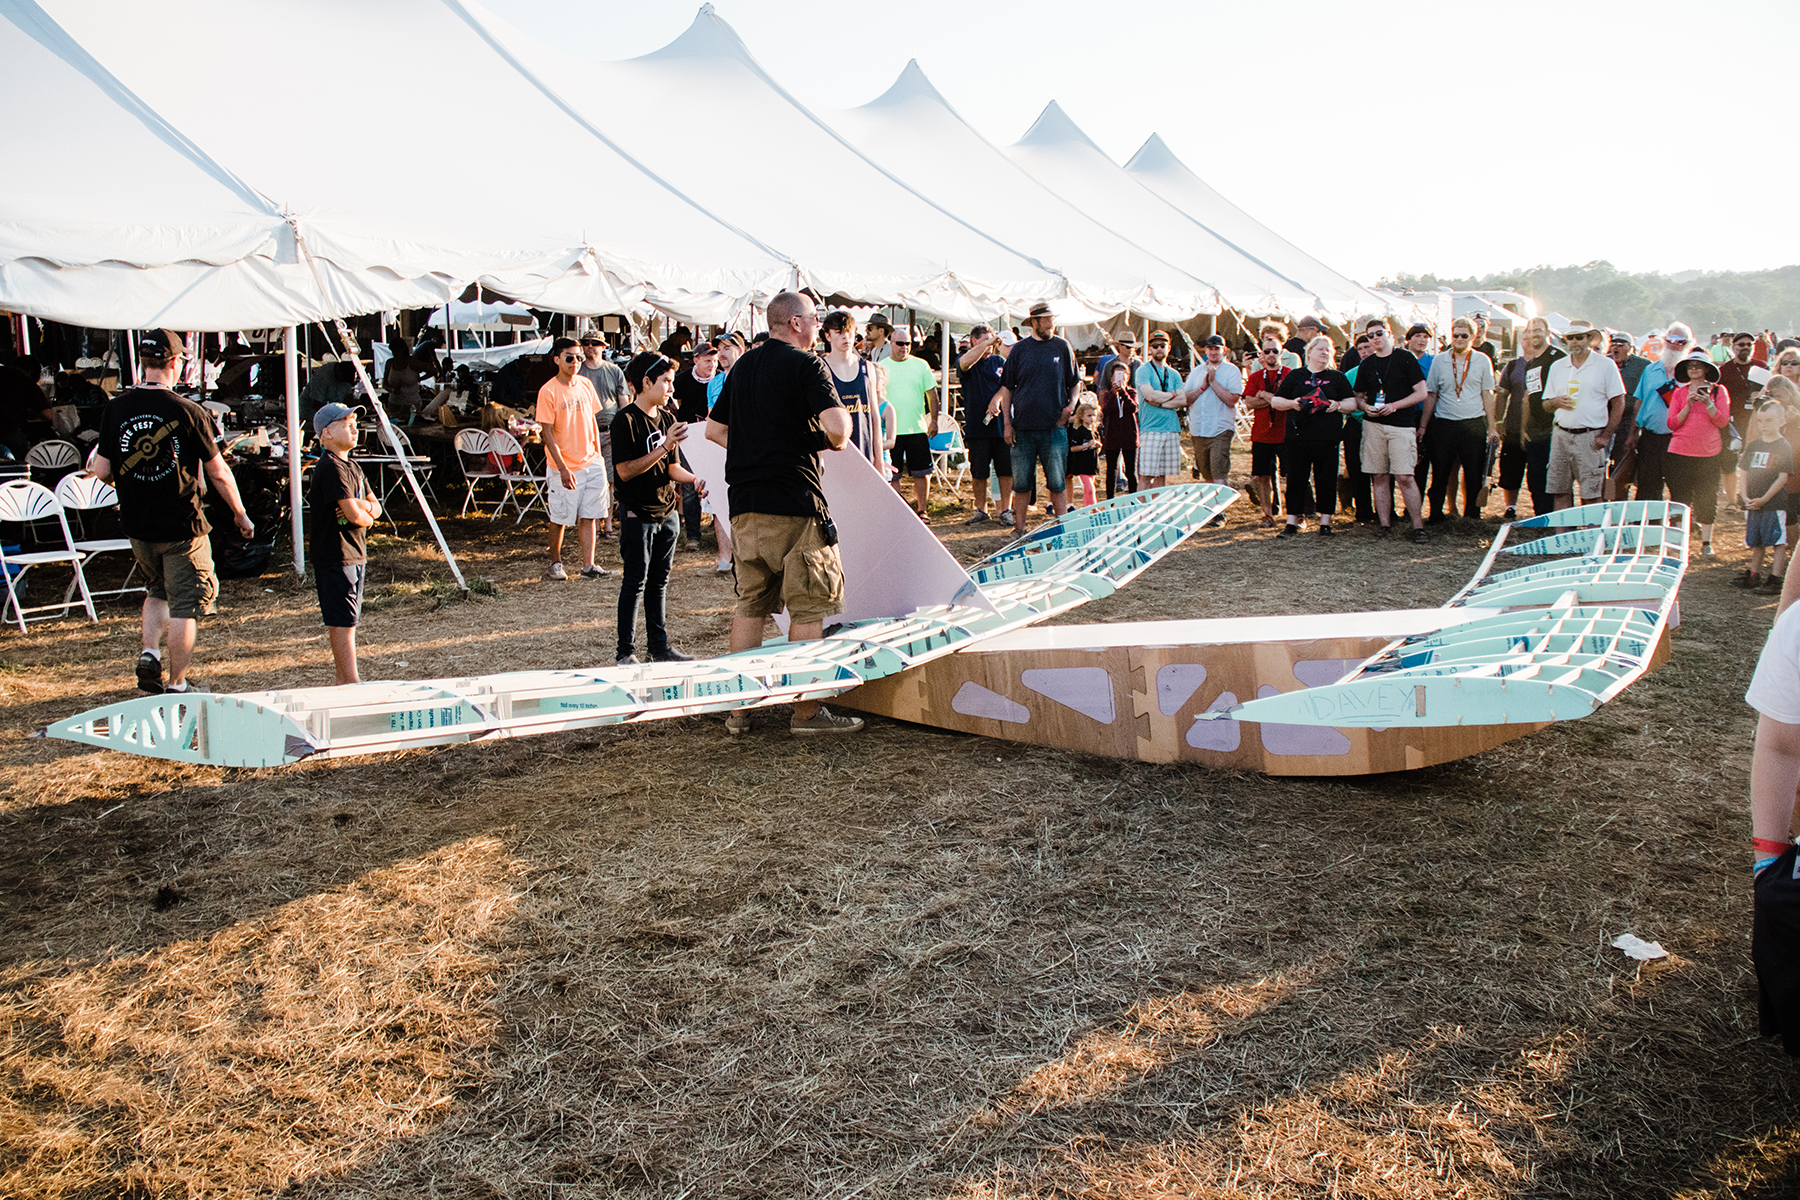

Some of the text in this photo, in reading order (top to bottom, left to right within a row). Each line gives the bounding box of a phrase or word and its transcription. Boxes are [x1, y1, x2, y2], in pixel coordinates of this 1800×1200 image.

[129, 414, 152, 422] MALVERN
[152, 414, 164, 423] OHIO
[120, 429, 134, 453] FLITE
[132, 420, 154, 432] FEST
[133, 472, 146, 482] THE
[1308, 683, 1414, 720] DAVEY
